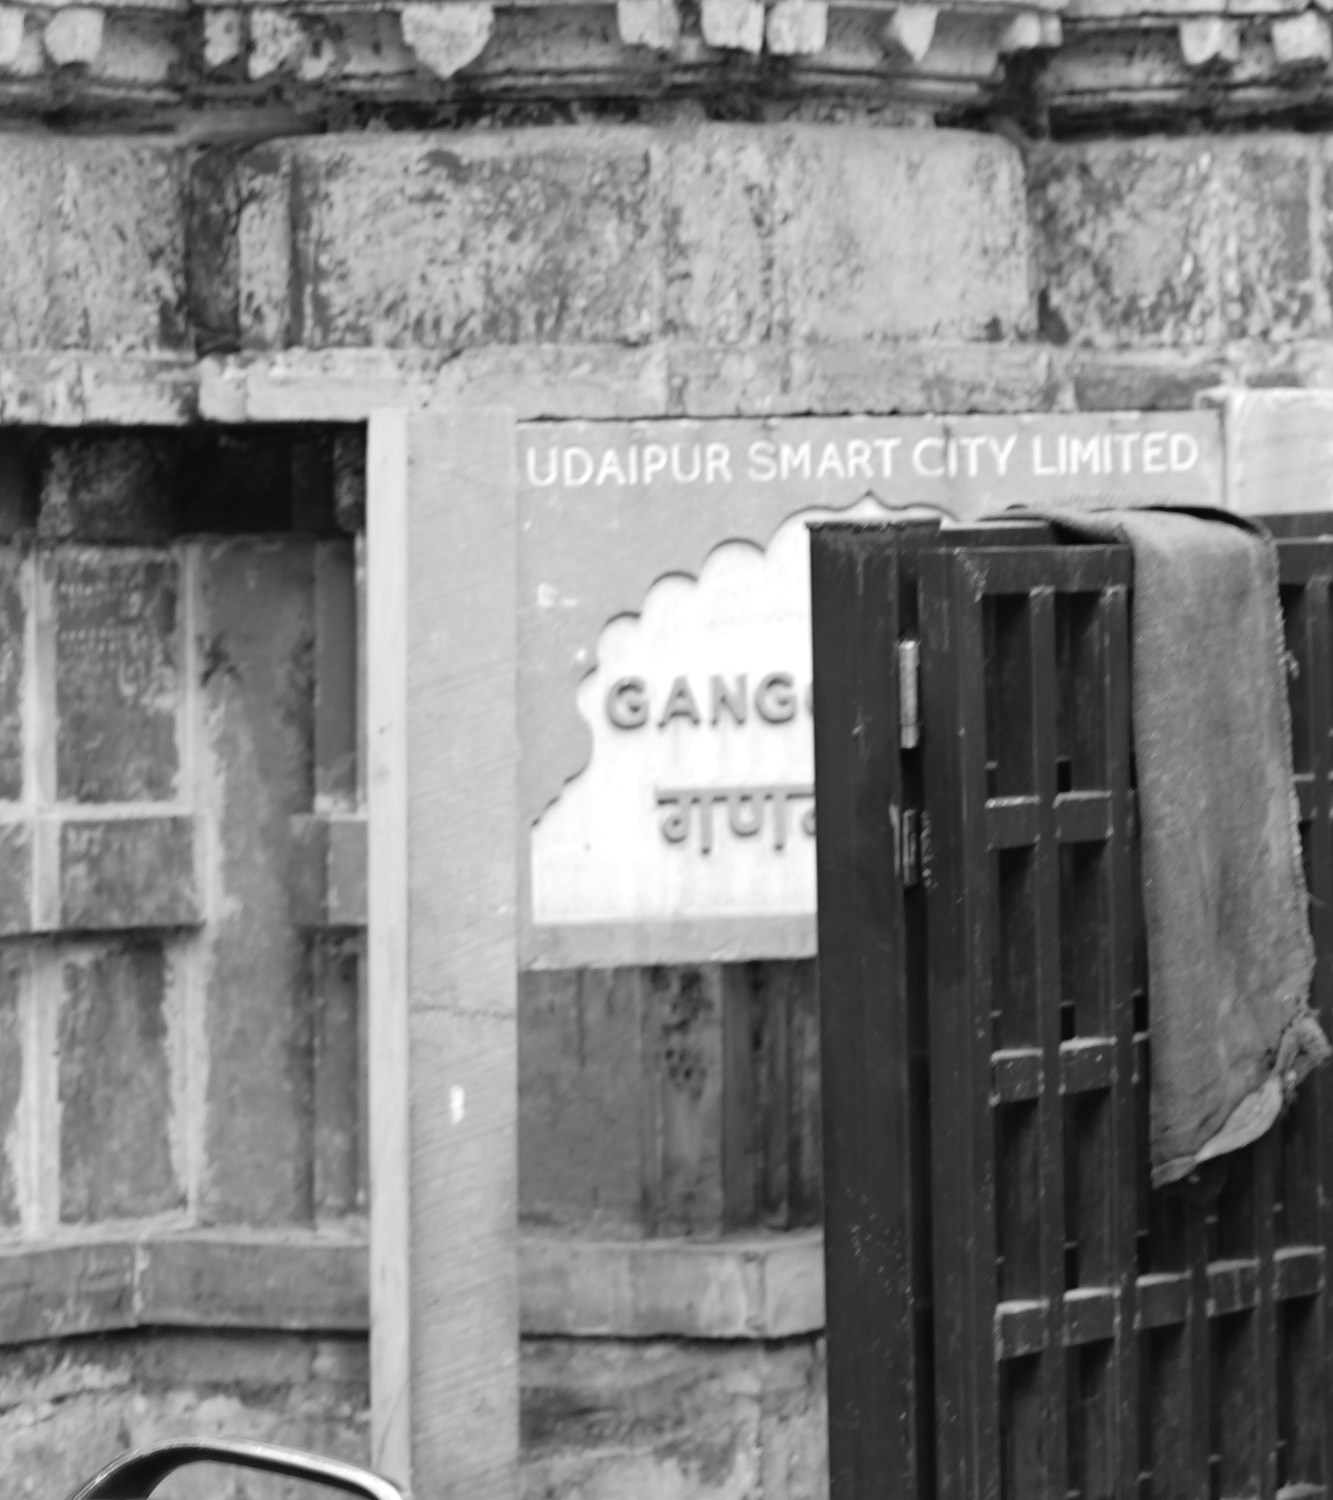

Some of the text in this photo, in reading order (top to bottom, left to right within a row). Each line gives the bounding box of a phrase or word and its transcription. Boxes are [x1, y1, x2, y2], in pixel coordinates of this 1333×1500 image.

[526, 430, 1199, 488] UDAIPUR SMART CITY LIMITED
[604, 670, 814, 731] GANG
